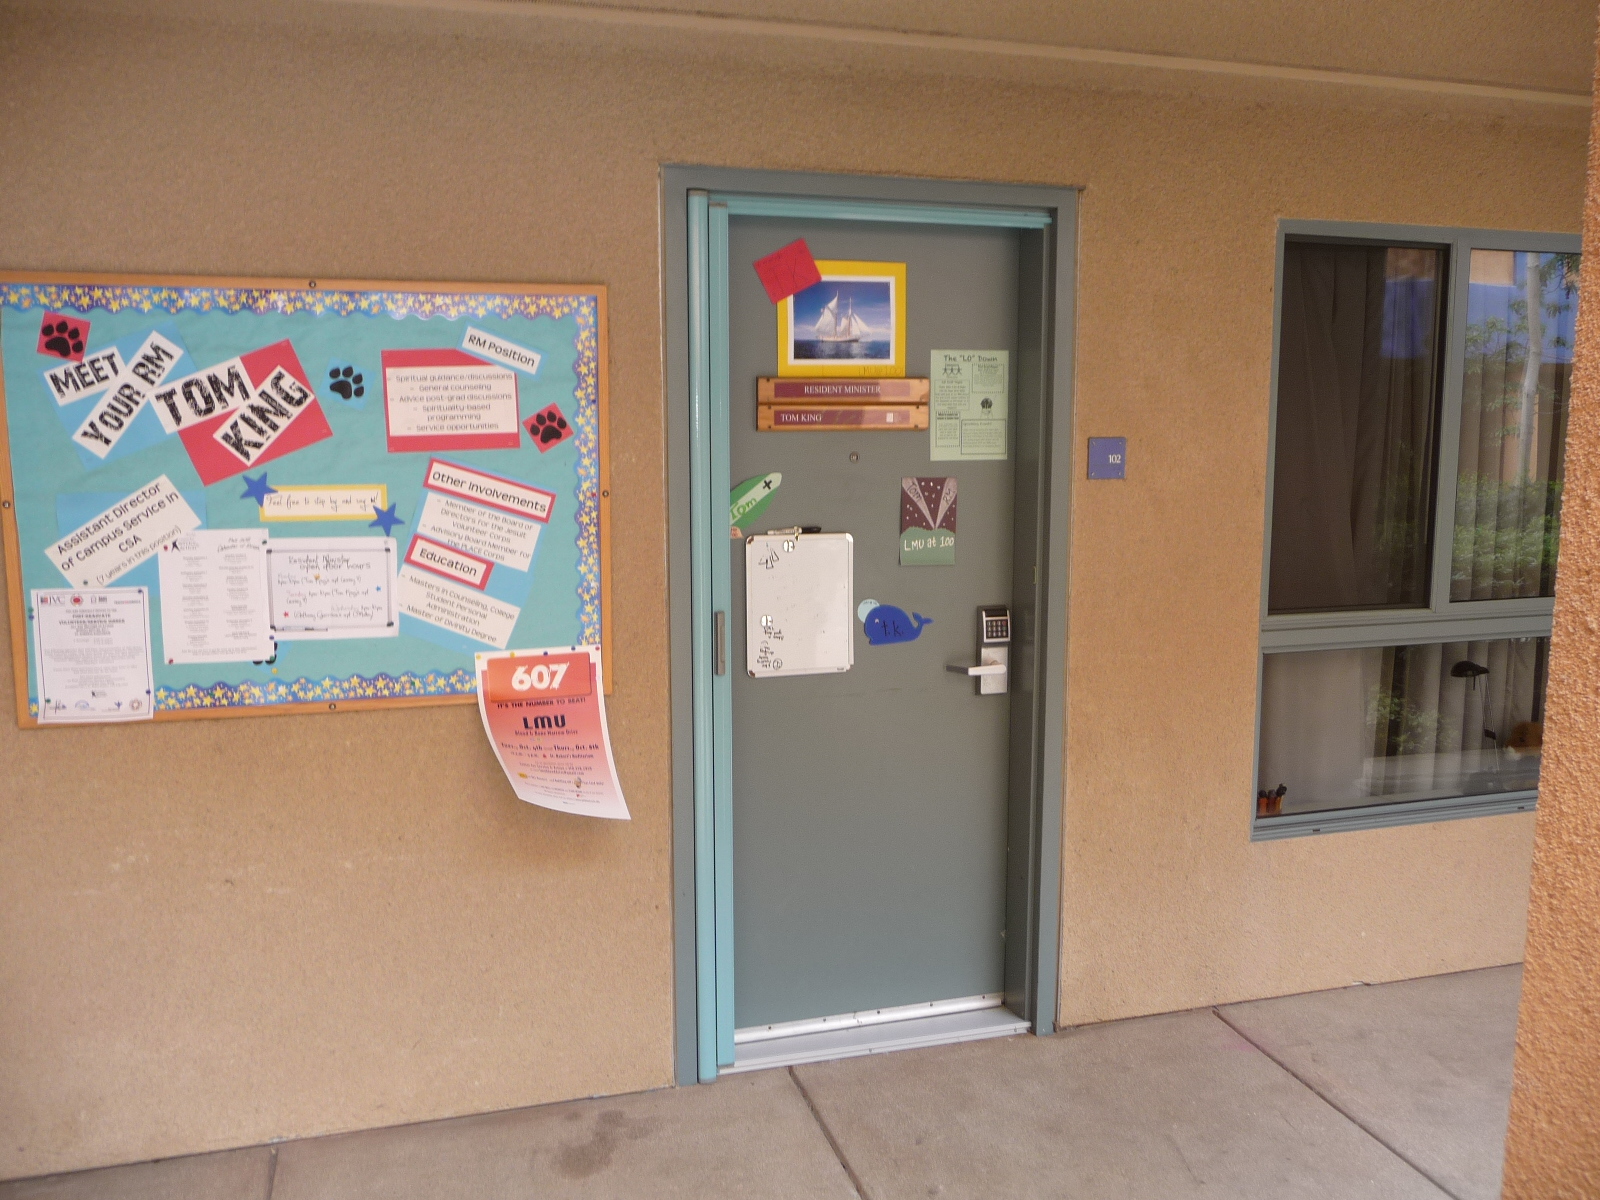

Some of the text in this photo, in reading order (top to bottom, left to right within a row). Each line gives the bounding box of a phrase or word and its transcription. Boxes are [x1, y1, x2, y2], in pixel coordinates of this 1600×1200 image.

[468, 334, 536, 368] RM Position
[943, 353, 957, 362] The
[50, 353, 119, 399] MEET
[80, 341, 175, 447] YOUR RM
[155, 364, 251, 427] TOM
[804, 385, 881, 395] RESIDENT MINISTER
[221, 370, 312, 463] KING
[780, 413, 822, 422] TOM KING
[416, 423, 499, 432] Service opportunities
[1108, 454, 1121, 464] 102
[432, 471, 547, 512] Other Involvements
[57, 482, 161, 556] Assistant Director
[440, 508, 476, 524] Directors
[445, 500, 476, 514] Member
[501, 515, 523, 529] Board
[76, 526, 123, 563] Campus
[122, 499, 166, 531] Service
[452, 521, 488, 537] Volunteer
[118, 534, 142, 553] CSA
[904, 536, 955, 551] LMU at 100
[419, 548, 477, 577] Education
[409, 576, 440, 593] Masters
[426, 592, 455, 607] Student
[406, 605, 434, 620] Master
[426, 602, 480, 626] Administration
[511, 662, 570, 691] 607
[523, 714, 566, 730] LMU
